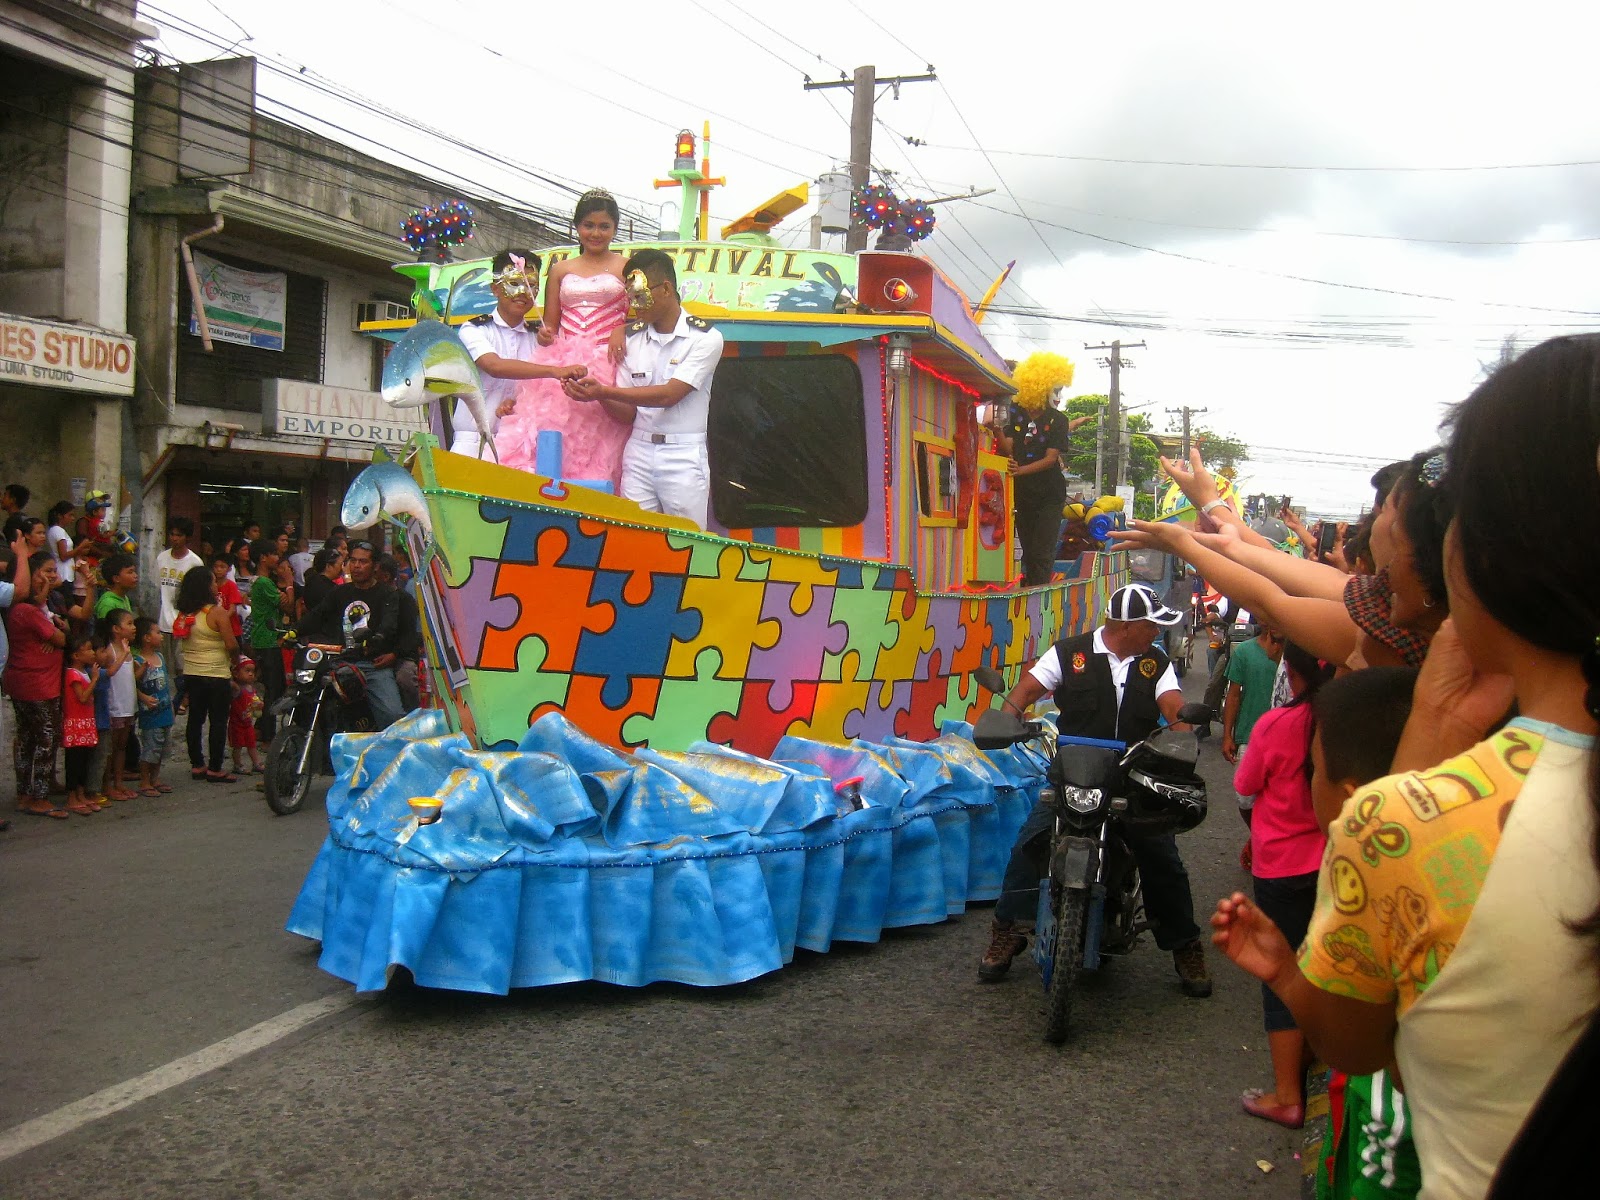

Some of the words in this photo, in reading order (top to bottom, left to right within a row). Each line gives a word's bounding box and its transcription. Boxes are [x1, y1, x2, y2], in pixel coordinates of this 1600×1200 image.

[609, 247, 806, 280] TIVAL
[0, 323, 36, 362] ES
[44, 330, 131, 374] STUDIO
[33, 365, 75, 383] STUDIO
[283, 416, 411, 444] EMPORIU
